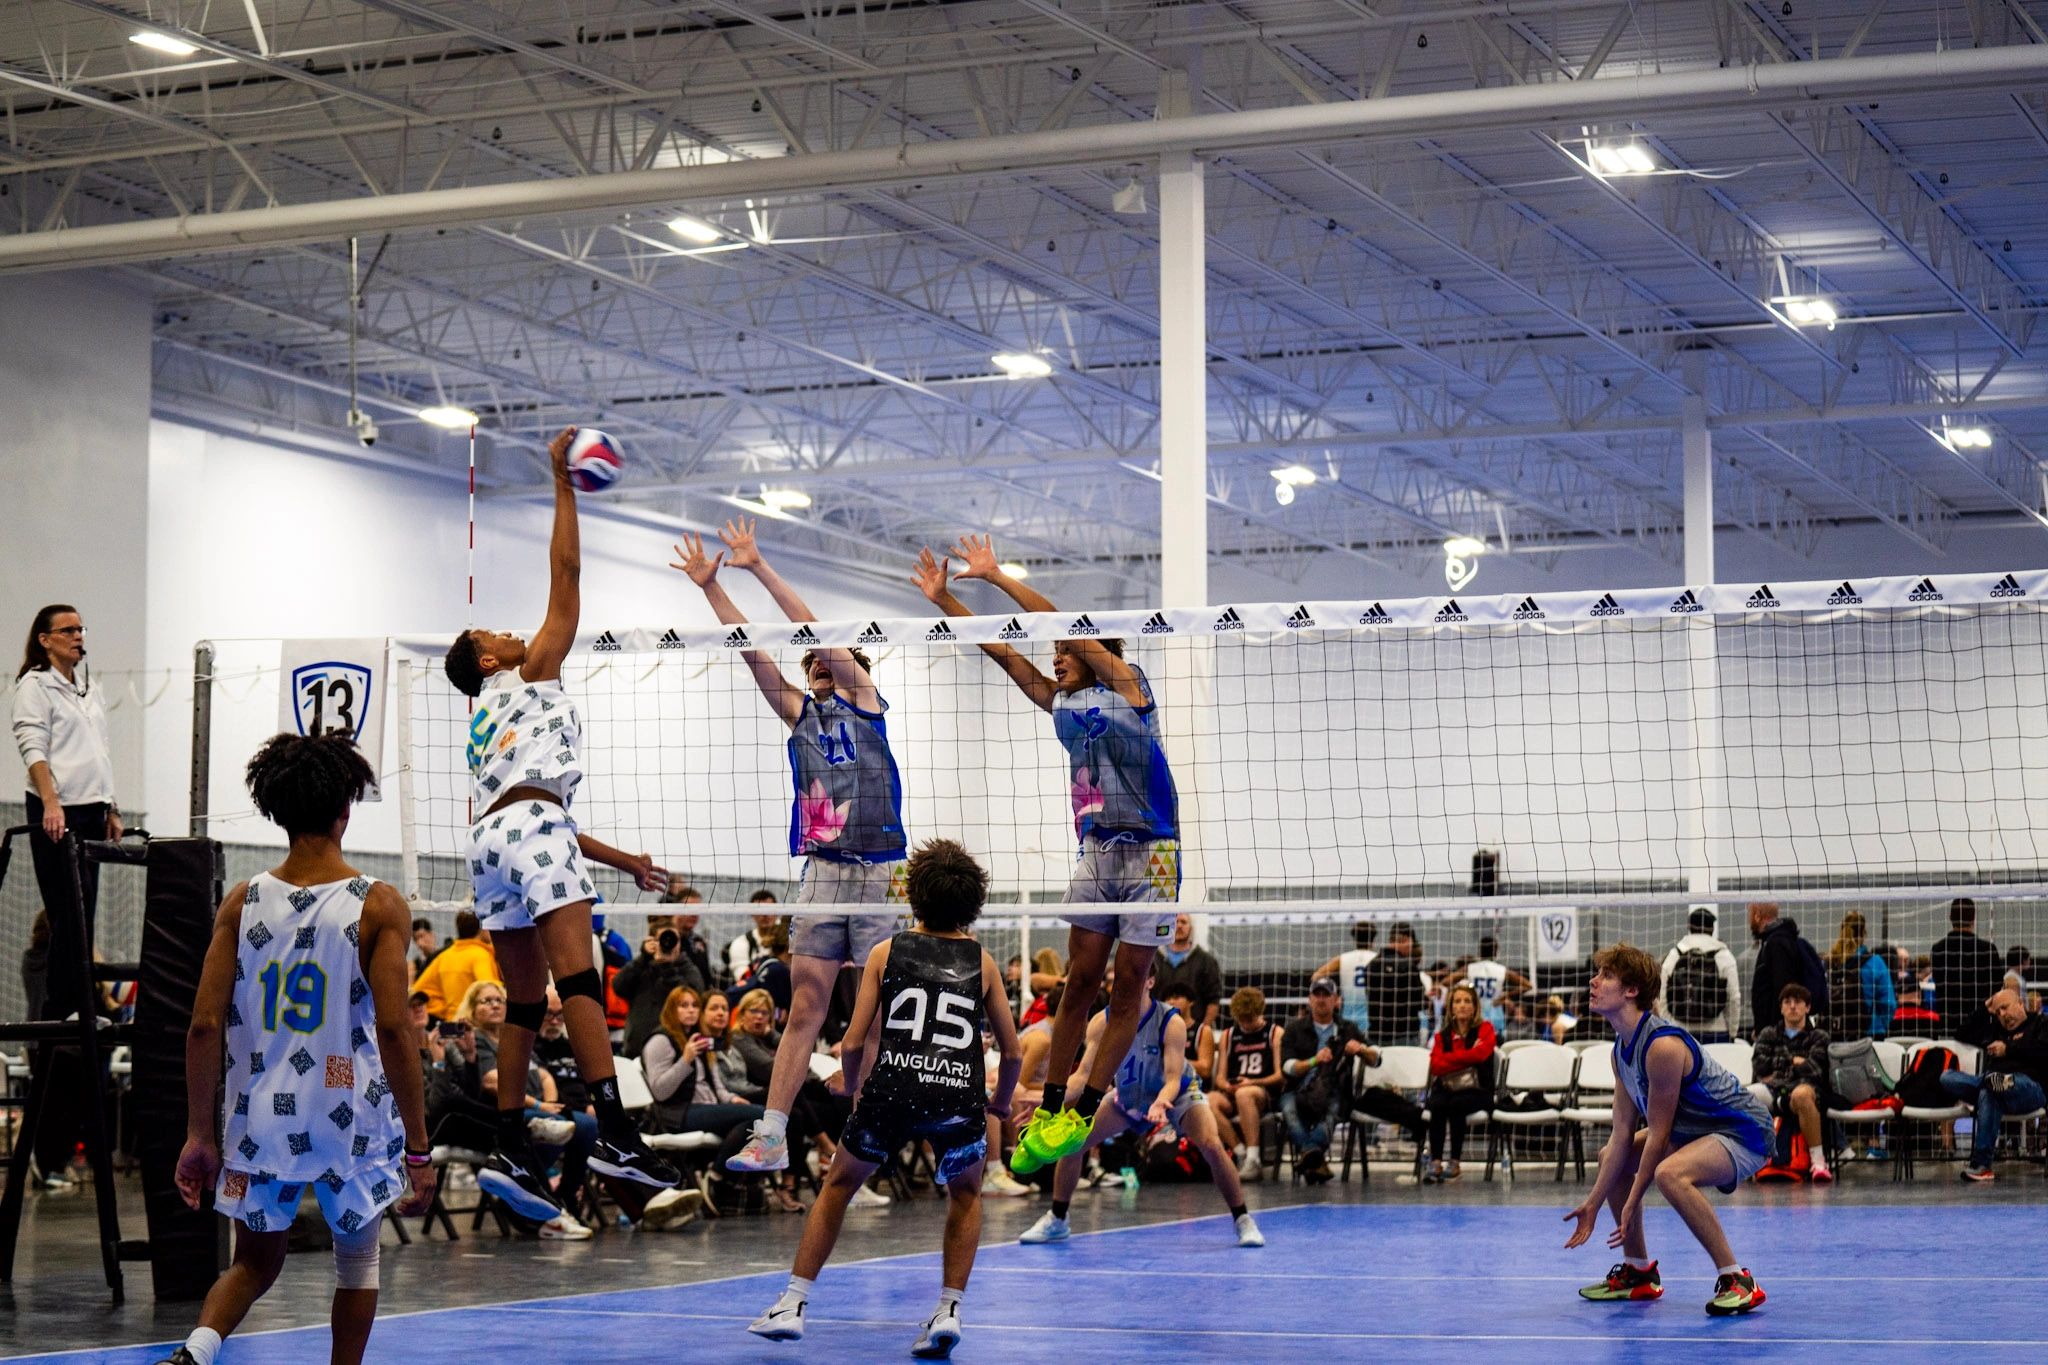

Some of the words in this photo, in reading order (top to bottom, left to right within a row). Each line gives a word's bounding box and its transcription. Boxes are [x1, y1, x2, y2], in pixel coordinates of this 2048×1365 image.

[1908, 591, 1944, 601] adidas
[1989, 587, 2026, 598] adidas
[1745, 598, 1781, 609] adidas
[1826, 594, 1863, 605] adidas
[1590, 606, 1625, 617] adidas
[1670, 603, 1704, 613] adidas
[1359, 615, 1393, 625] adidas
[1434, 612, 1469, 623] adidas
[1512, 610, 1545, 620] adidas
[1141, 623, 1174, 634] adidas
[1213, 620, 1245, 631] adidas
[1286, 618, 1315, 629] adidas
[925, 631, 957, 641] adidas
[998, 630, 1028, 639] adidas
[1068, 626, 1100, 636] adidas
[723, 638, 752, 648] adidas
[790, 636, 821, 645] adidas
[856, 634, 888, 644] adidas
[593, 643, 621, 652] adidas
[656, 640, 686, 650] adidas
[307, 678, 354, 736] 13
[1548, 919, 1564, 941] 12
[1473, 977, 1497, 998] 55
[258, 960, 328, 1036] 19
[886, 987, 976, 1050] 45
[881, 1050, 971, 1078] ANGUARD
[1238, 1052, 1263, 1075] 18
[918, 1072, 970, 1089] VOLLEYBALL
